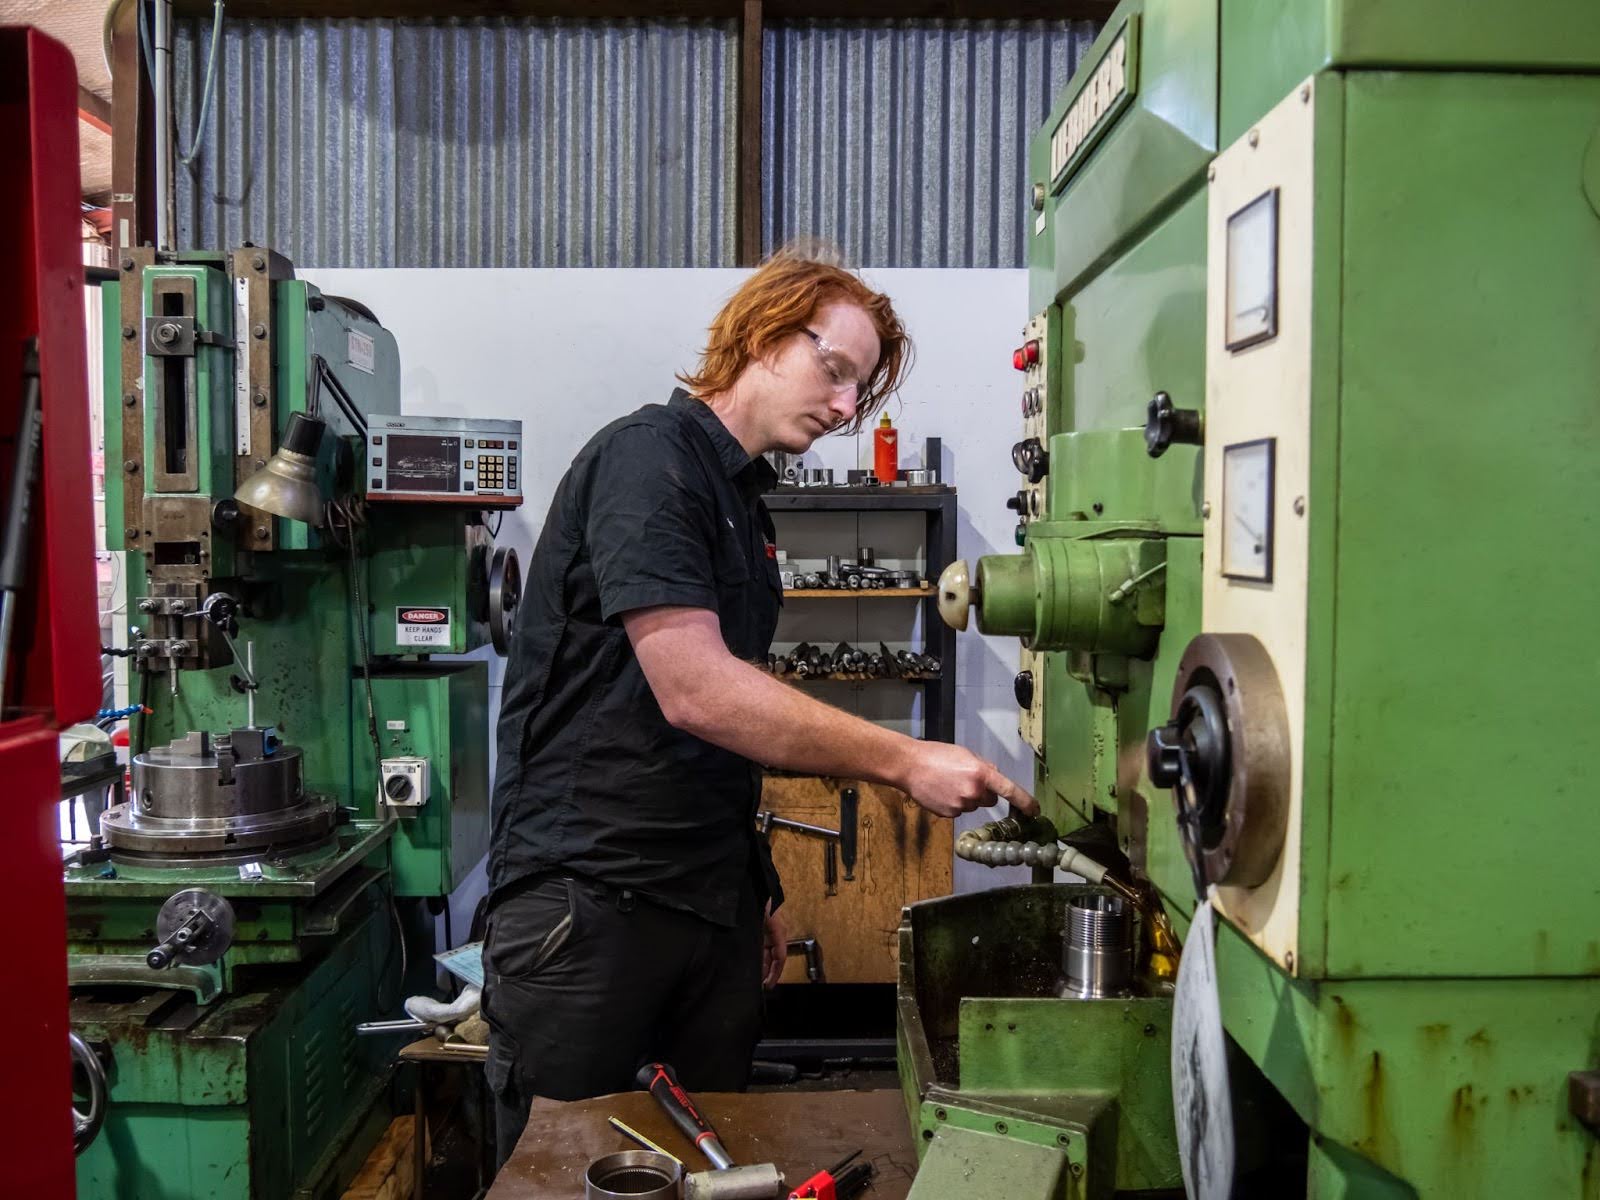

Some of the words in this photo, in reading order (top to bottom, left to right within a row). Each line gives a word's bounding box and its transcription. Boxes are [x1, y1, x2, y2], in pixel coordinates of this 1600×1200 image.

[1051, 36, 1126, 183] LIEBHERR
[408, 612, 439, 620] DANGER
[422, 626, 442, 634] HANDS
